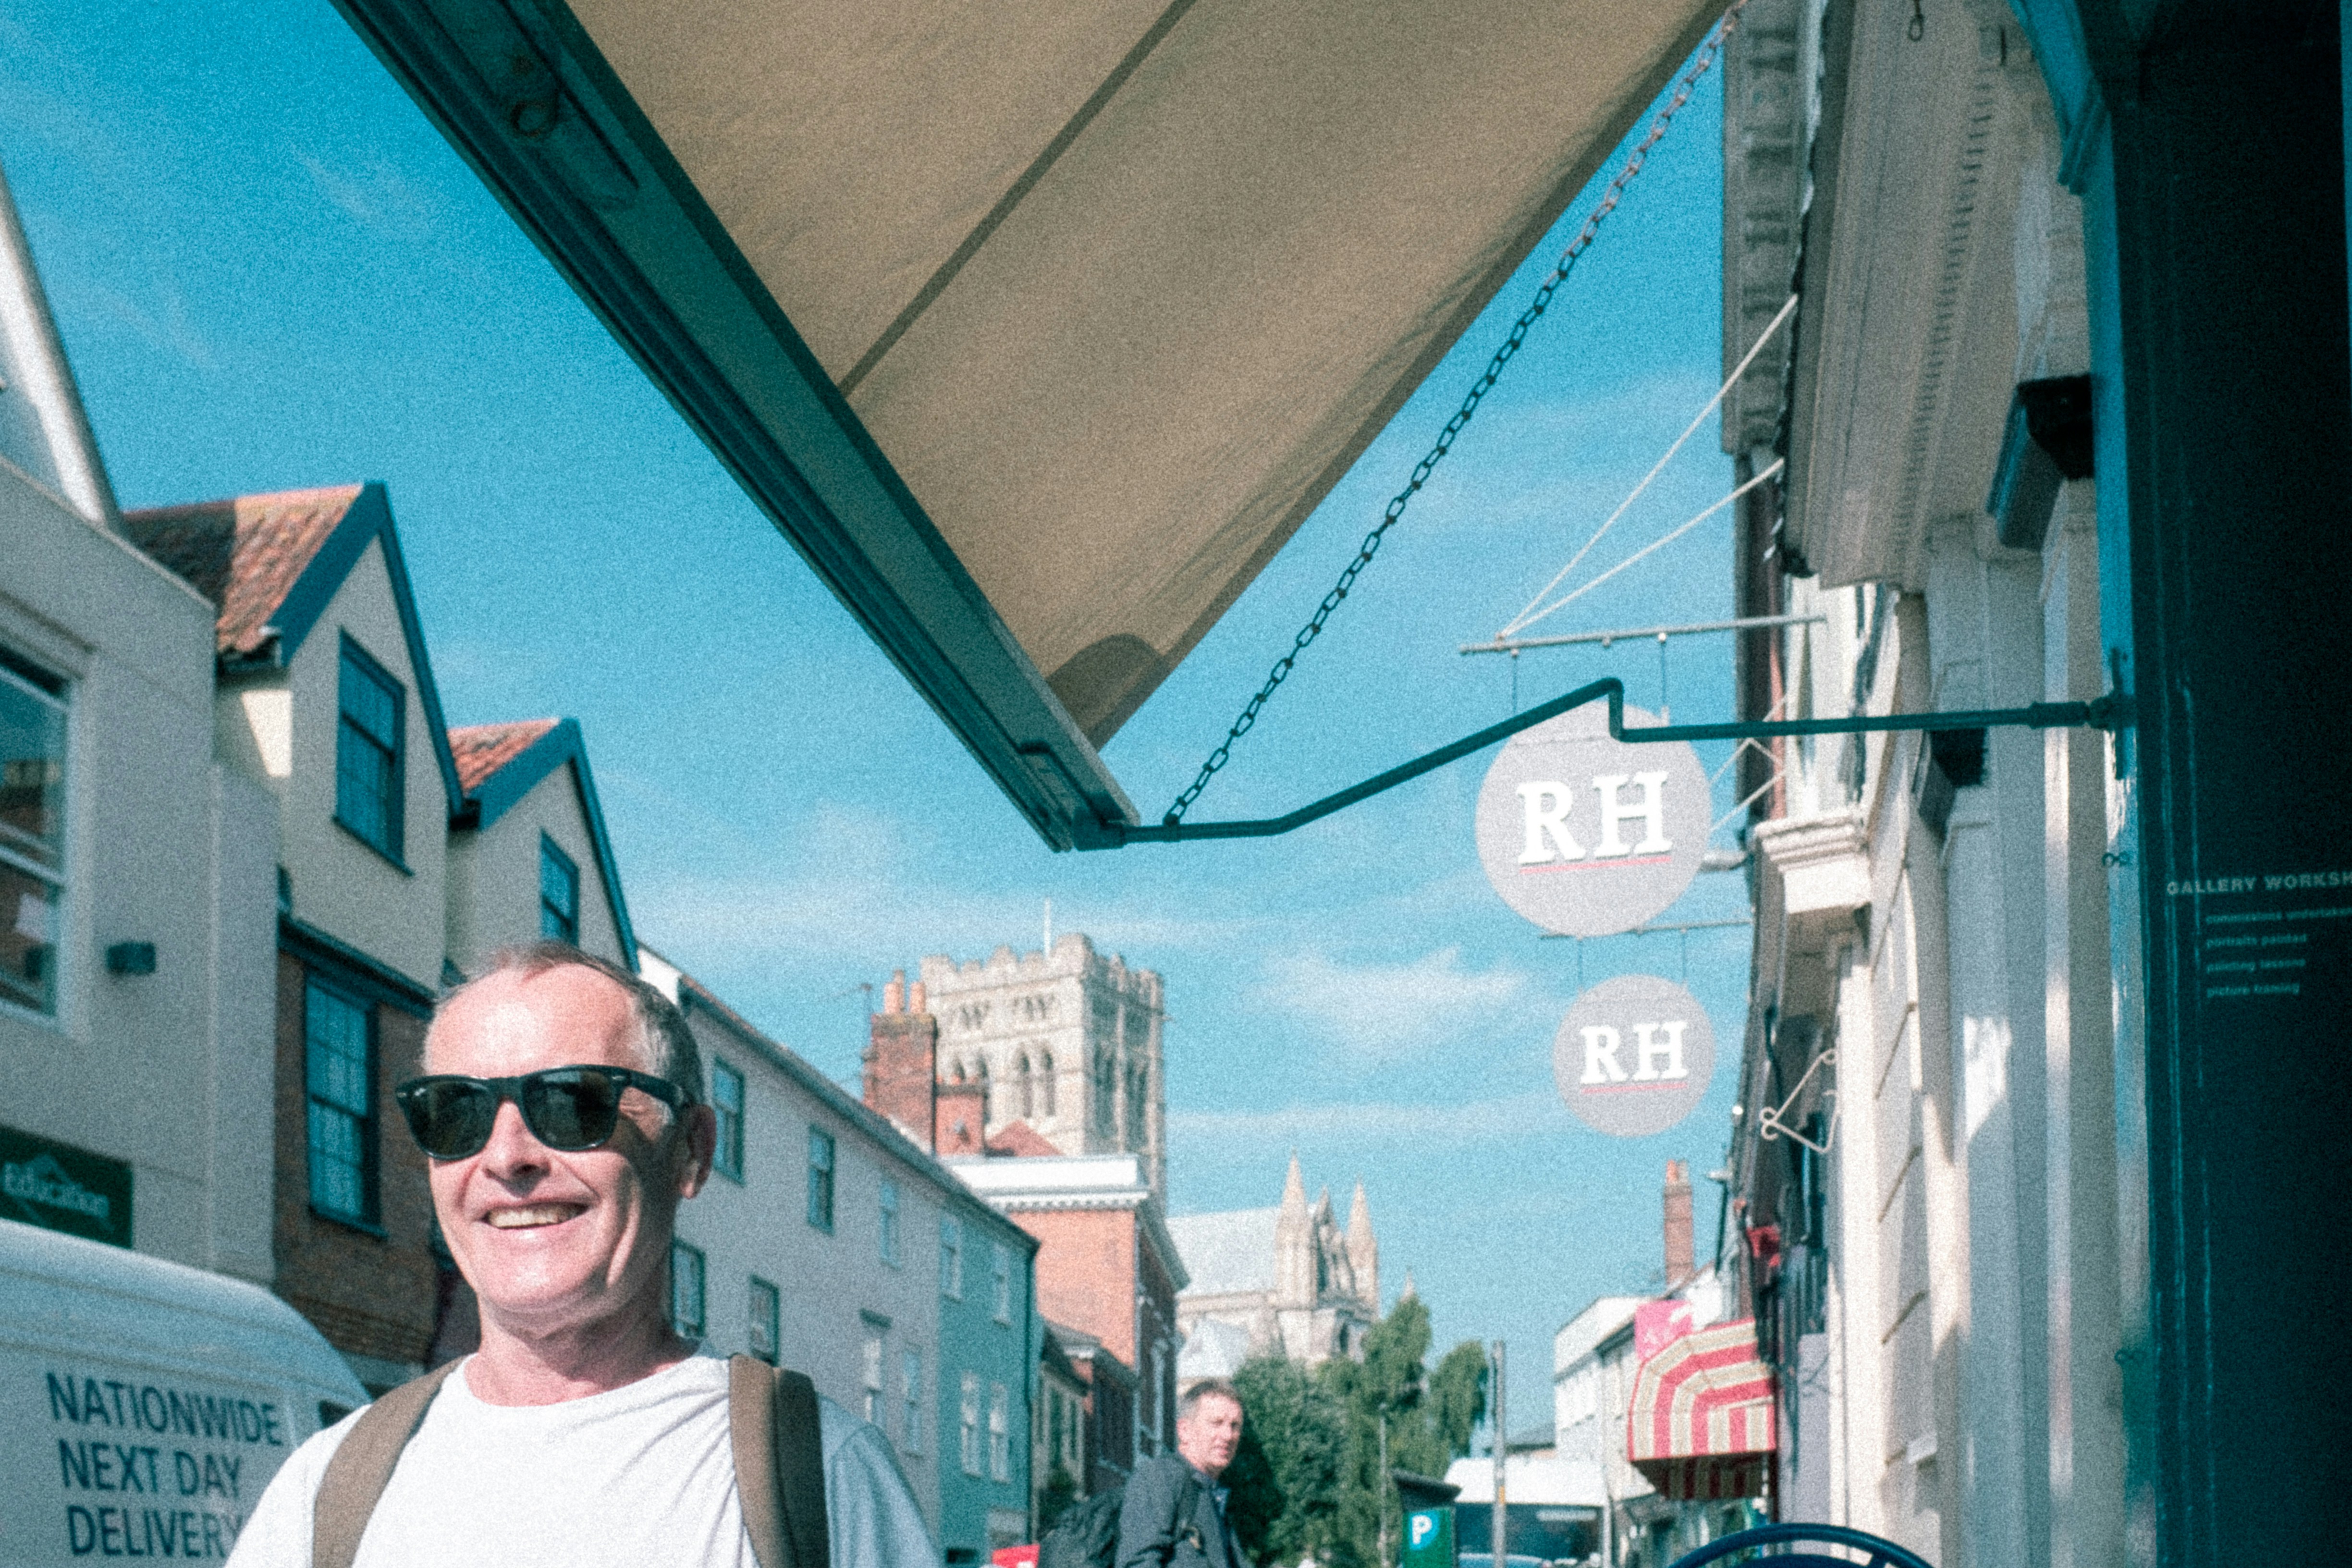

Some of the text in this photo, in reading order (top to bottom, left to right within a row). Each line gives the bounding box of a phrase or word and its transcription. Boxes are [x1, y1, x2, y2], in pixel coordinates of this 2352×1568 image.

[1516, 771, 1673, 866] RH
[2167, 878, 2256, 895] GALLERY
[1580, 1021, 1688, 1085] RH
[47, 1372, 283, 1447] NATIONWIDE
[58, 1439, 242, 1500] NEXT DAY
